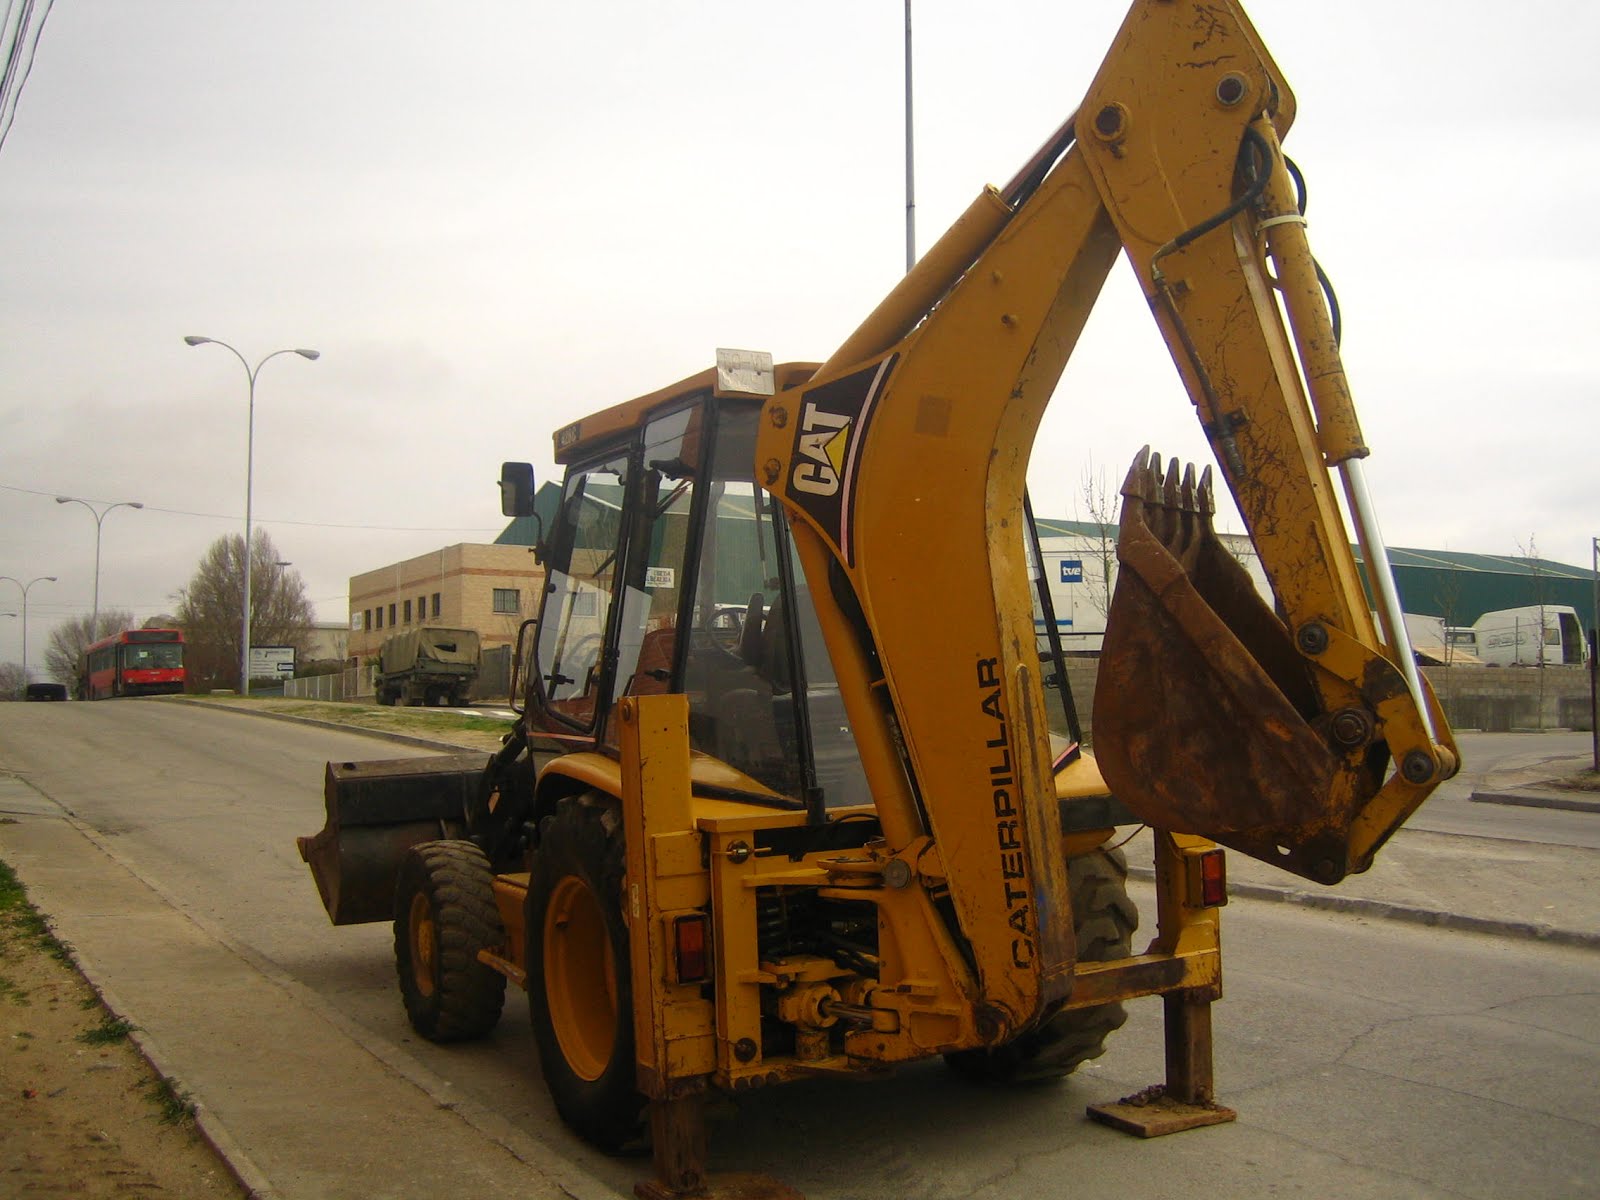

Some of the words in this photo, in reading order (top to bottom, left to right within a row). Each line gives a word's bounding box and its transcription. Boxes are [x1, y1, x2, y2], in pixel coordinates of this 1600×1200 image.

[793, 403, 850, 497] CAT
[1063, 566, 1081, 575] tve
[977, 657, 1035, 970] CATERPILLAR
